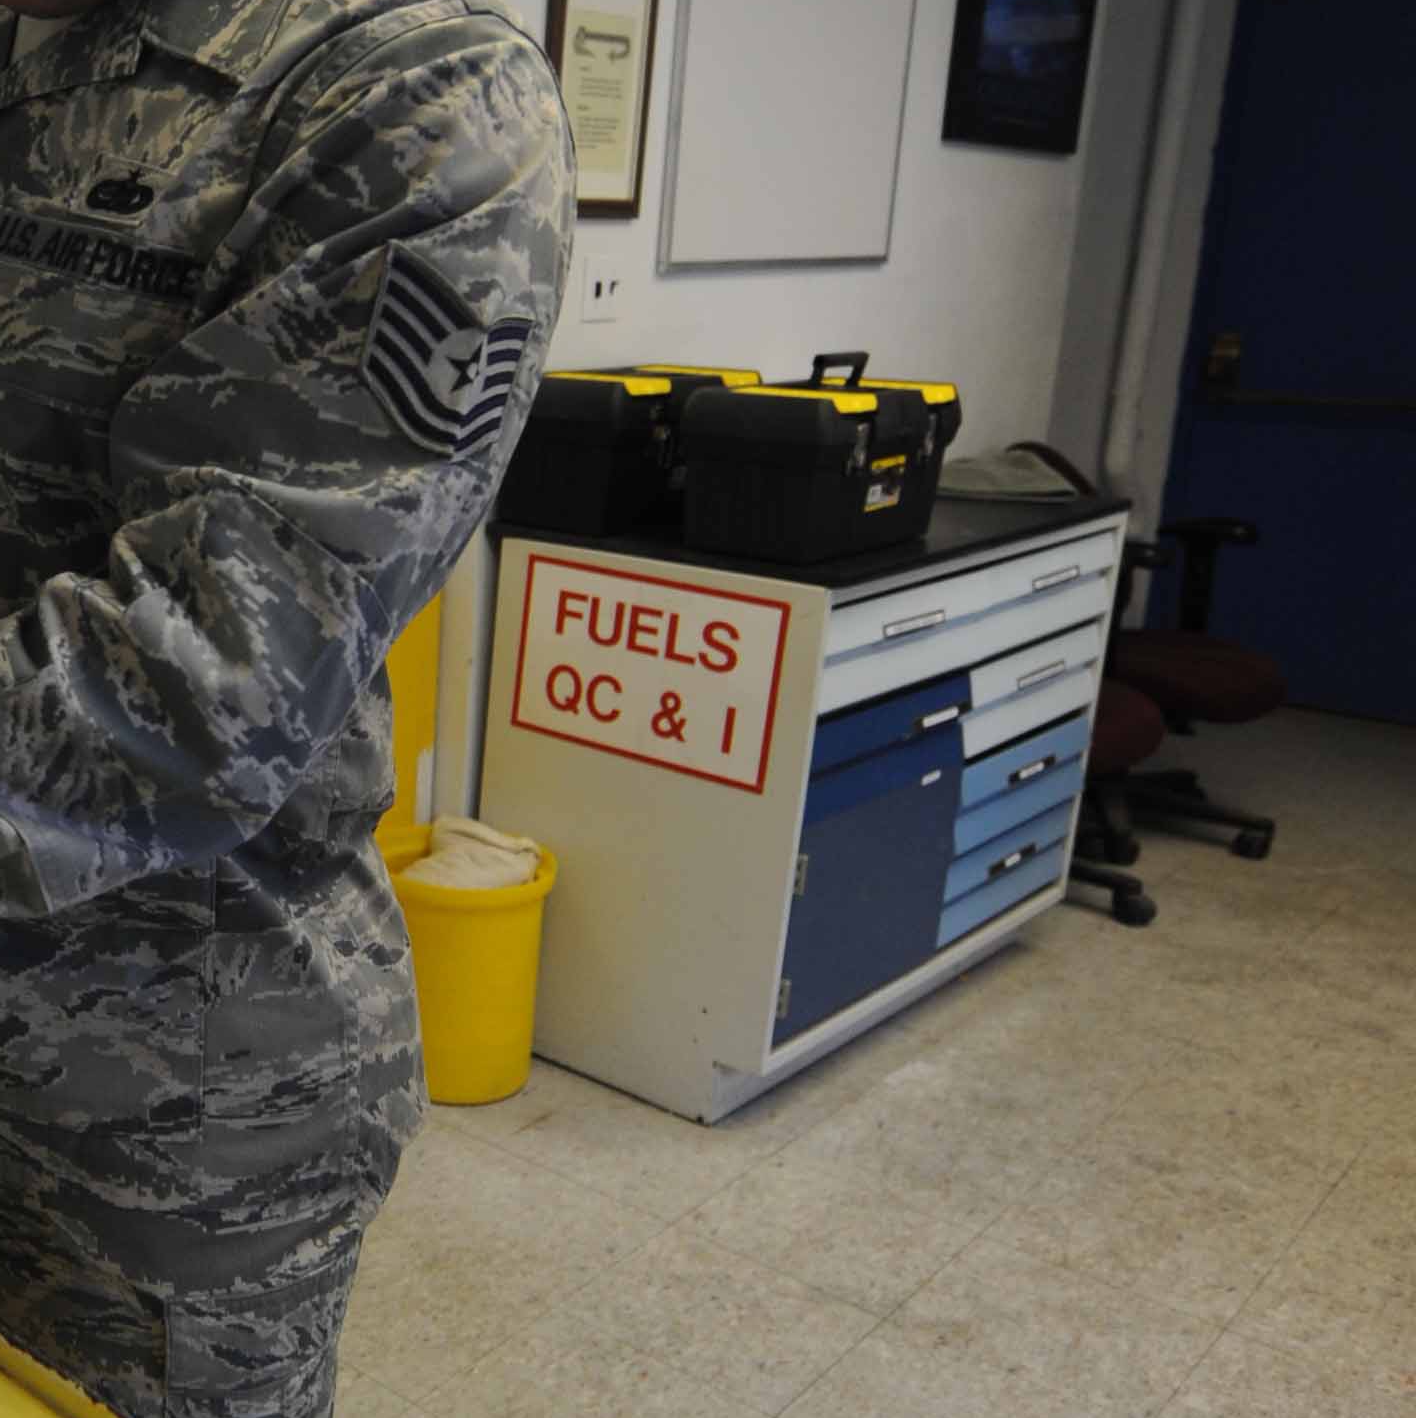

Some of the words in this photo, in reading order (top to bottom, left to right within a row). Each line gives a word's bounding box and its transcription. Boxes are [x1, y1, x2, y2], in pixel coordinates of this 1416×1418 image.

[34, 228, 90, 273] AIR
[555, 590, 740, 673] FUELS
[545, 664, 623, 723] QC
[650, 690, 687, 743] &
[720, 706, 736, 754] I
